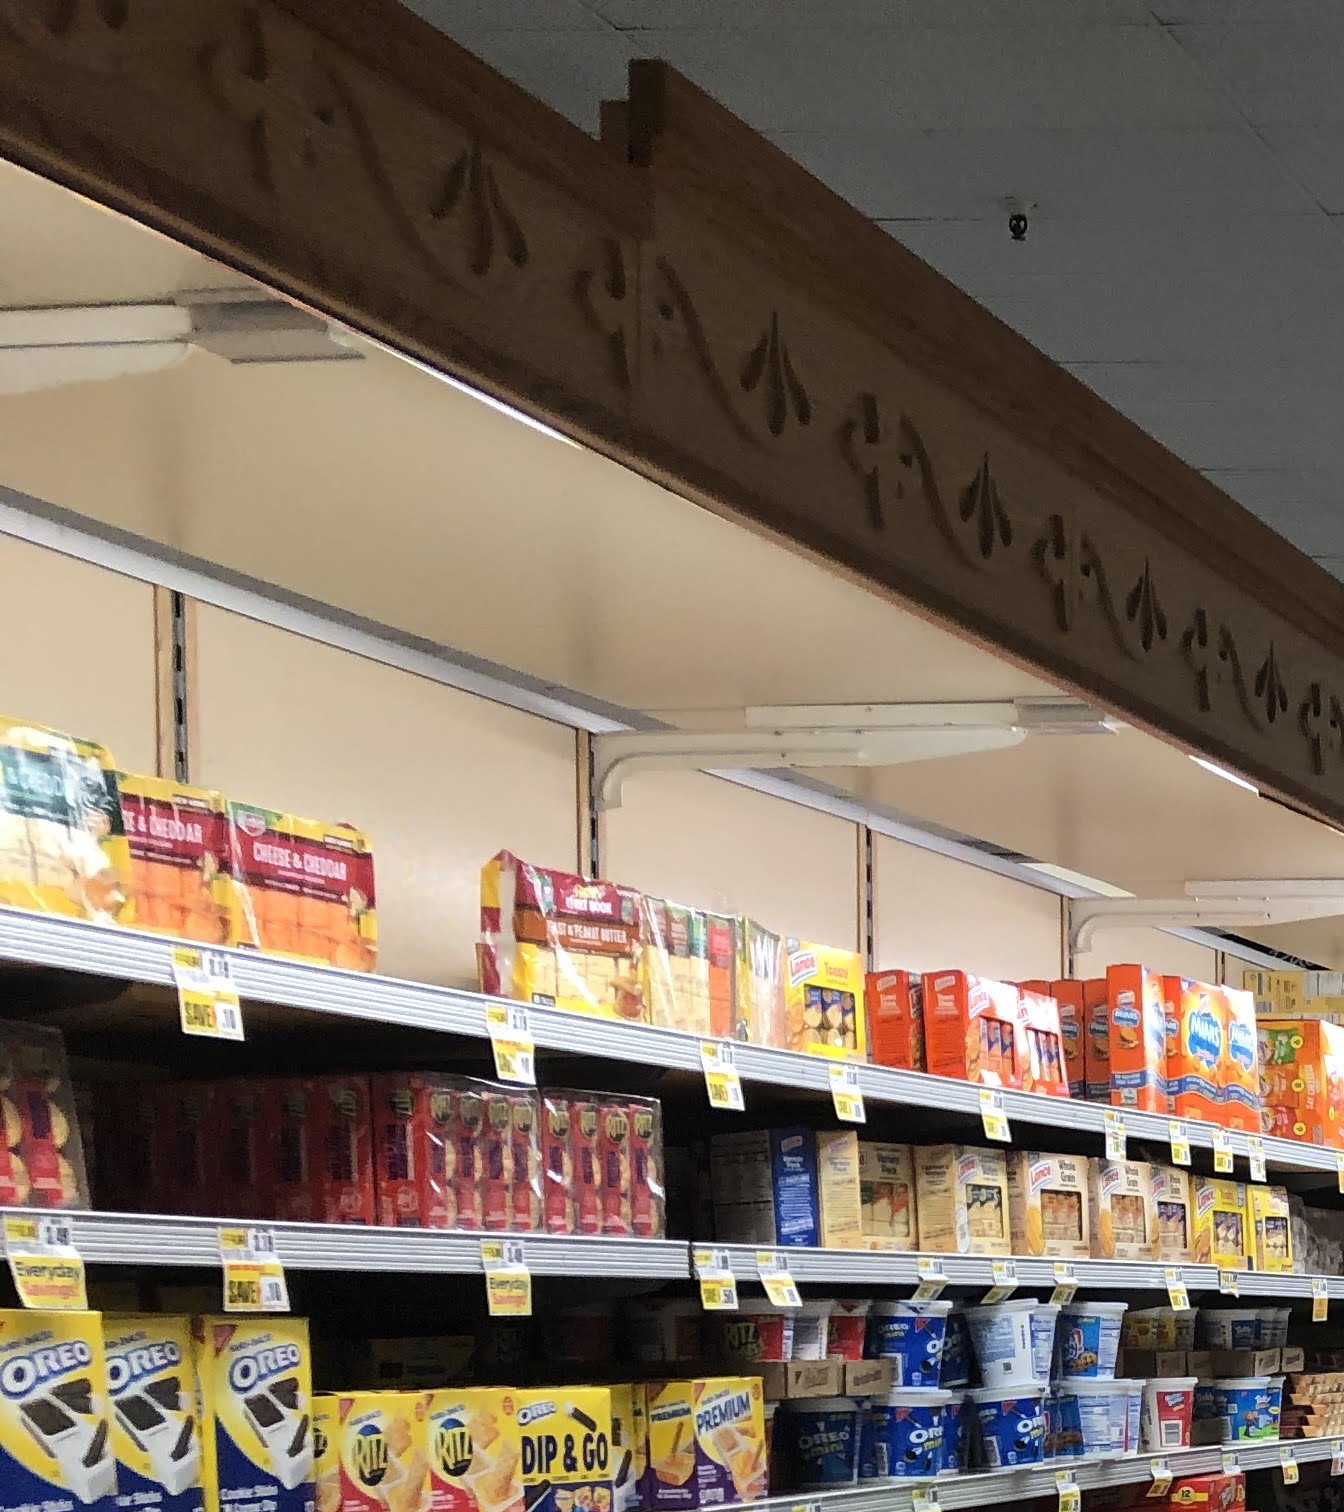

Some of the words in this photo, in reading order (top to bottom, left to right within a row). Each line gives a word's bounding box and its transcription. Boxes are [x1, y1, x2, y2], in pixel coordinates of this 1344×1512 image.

[252, 840, 291, 869] CHEESE
[302, 852, 348, 882] CHEDDAR
[1031, 1162, 1053, 1186] Lance
[16, 1261, 82, 1281] Everyday
[1, 1341, 93, 1396] OREO
[107, 1340, 181, 1393] OREO
[230, 1342, 300, 1393] OREO
[517, 1401, 557, 1426] OREO
[695, 1391, 751, 1433] PREMIUM
[353, 1436, 389, 1480] RITZ
[434, 1428, 474, 1470] RITZ
[521, 1435, 556, 1475] DIP
[562, 1436, 578, 1471] &
[582, 1433, 609, 1471] GO
[799, 1431, 851, 1450] OREO
[1181, 1489, 1191, 1498] 12
